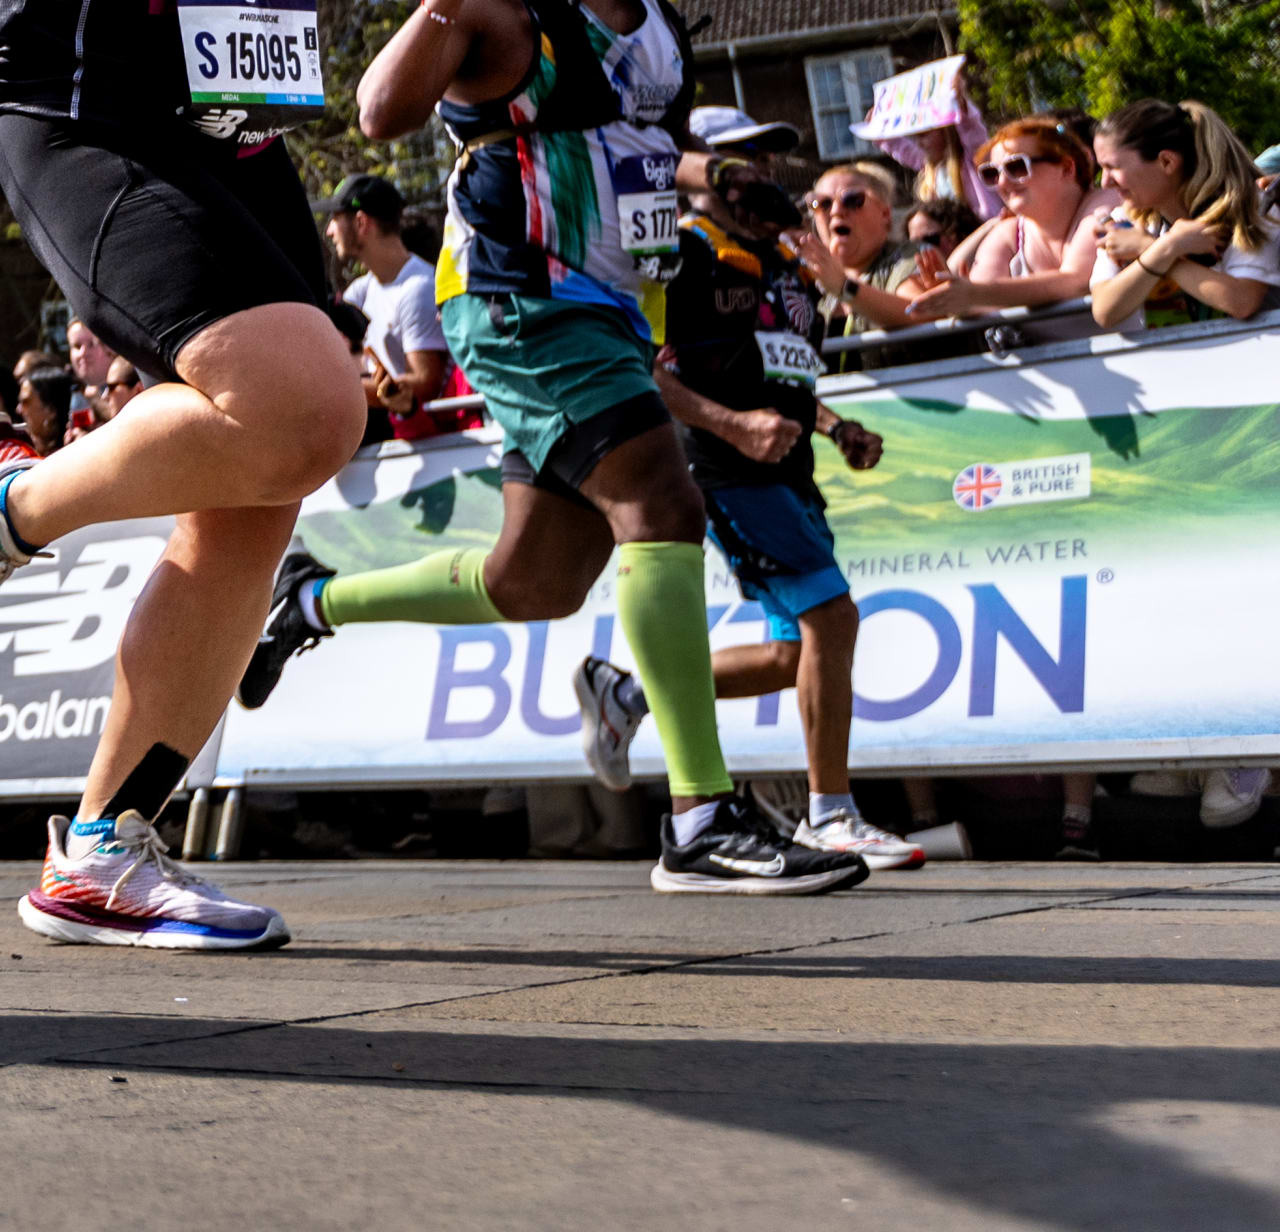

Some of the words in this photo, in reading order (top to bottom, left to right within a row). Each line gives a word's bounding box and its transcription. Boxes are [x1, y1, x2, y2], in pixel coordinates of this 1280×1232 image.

[195, 31, 219, 80] S
[226, 32, 301, 81] 15095
[632, 209, 646, 241] S
[1011, 484, 1024, 497] &
[1028, 479, 1075, 495] PURE
[1012, 462, 1080, 481] BRITISH
[847, 548, 971, 577] MINERAL
[986, 538, 1089, 565] WATER
[426, 573, 1089, 741] BUON
